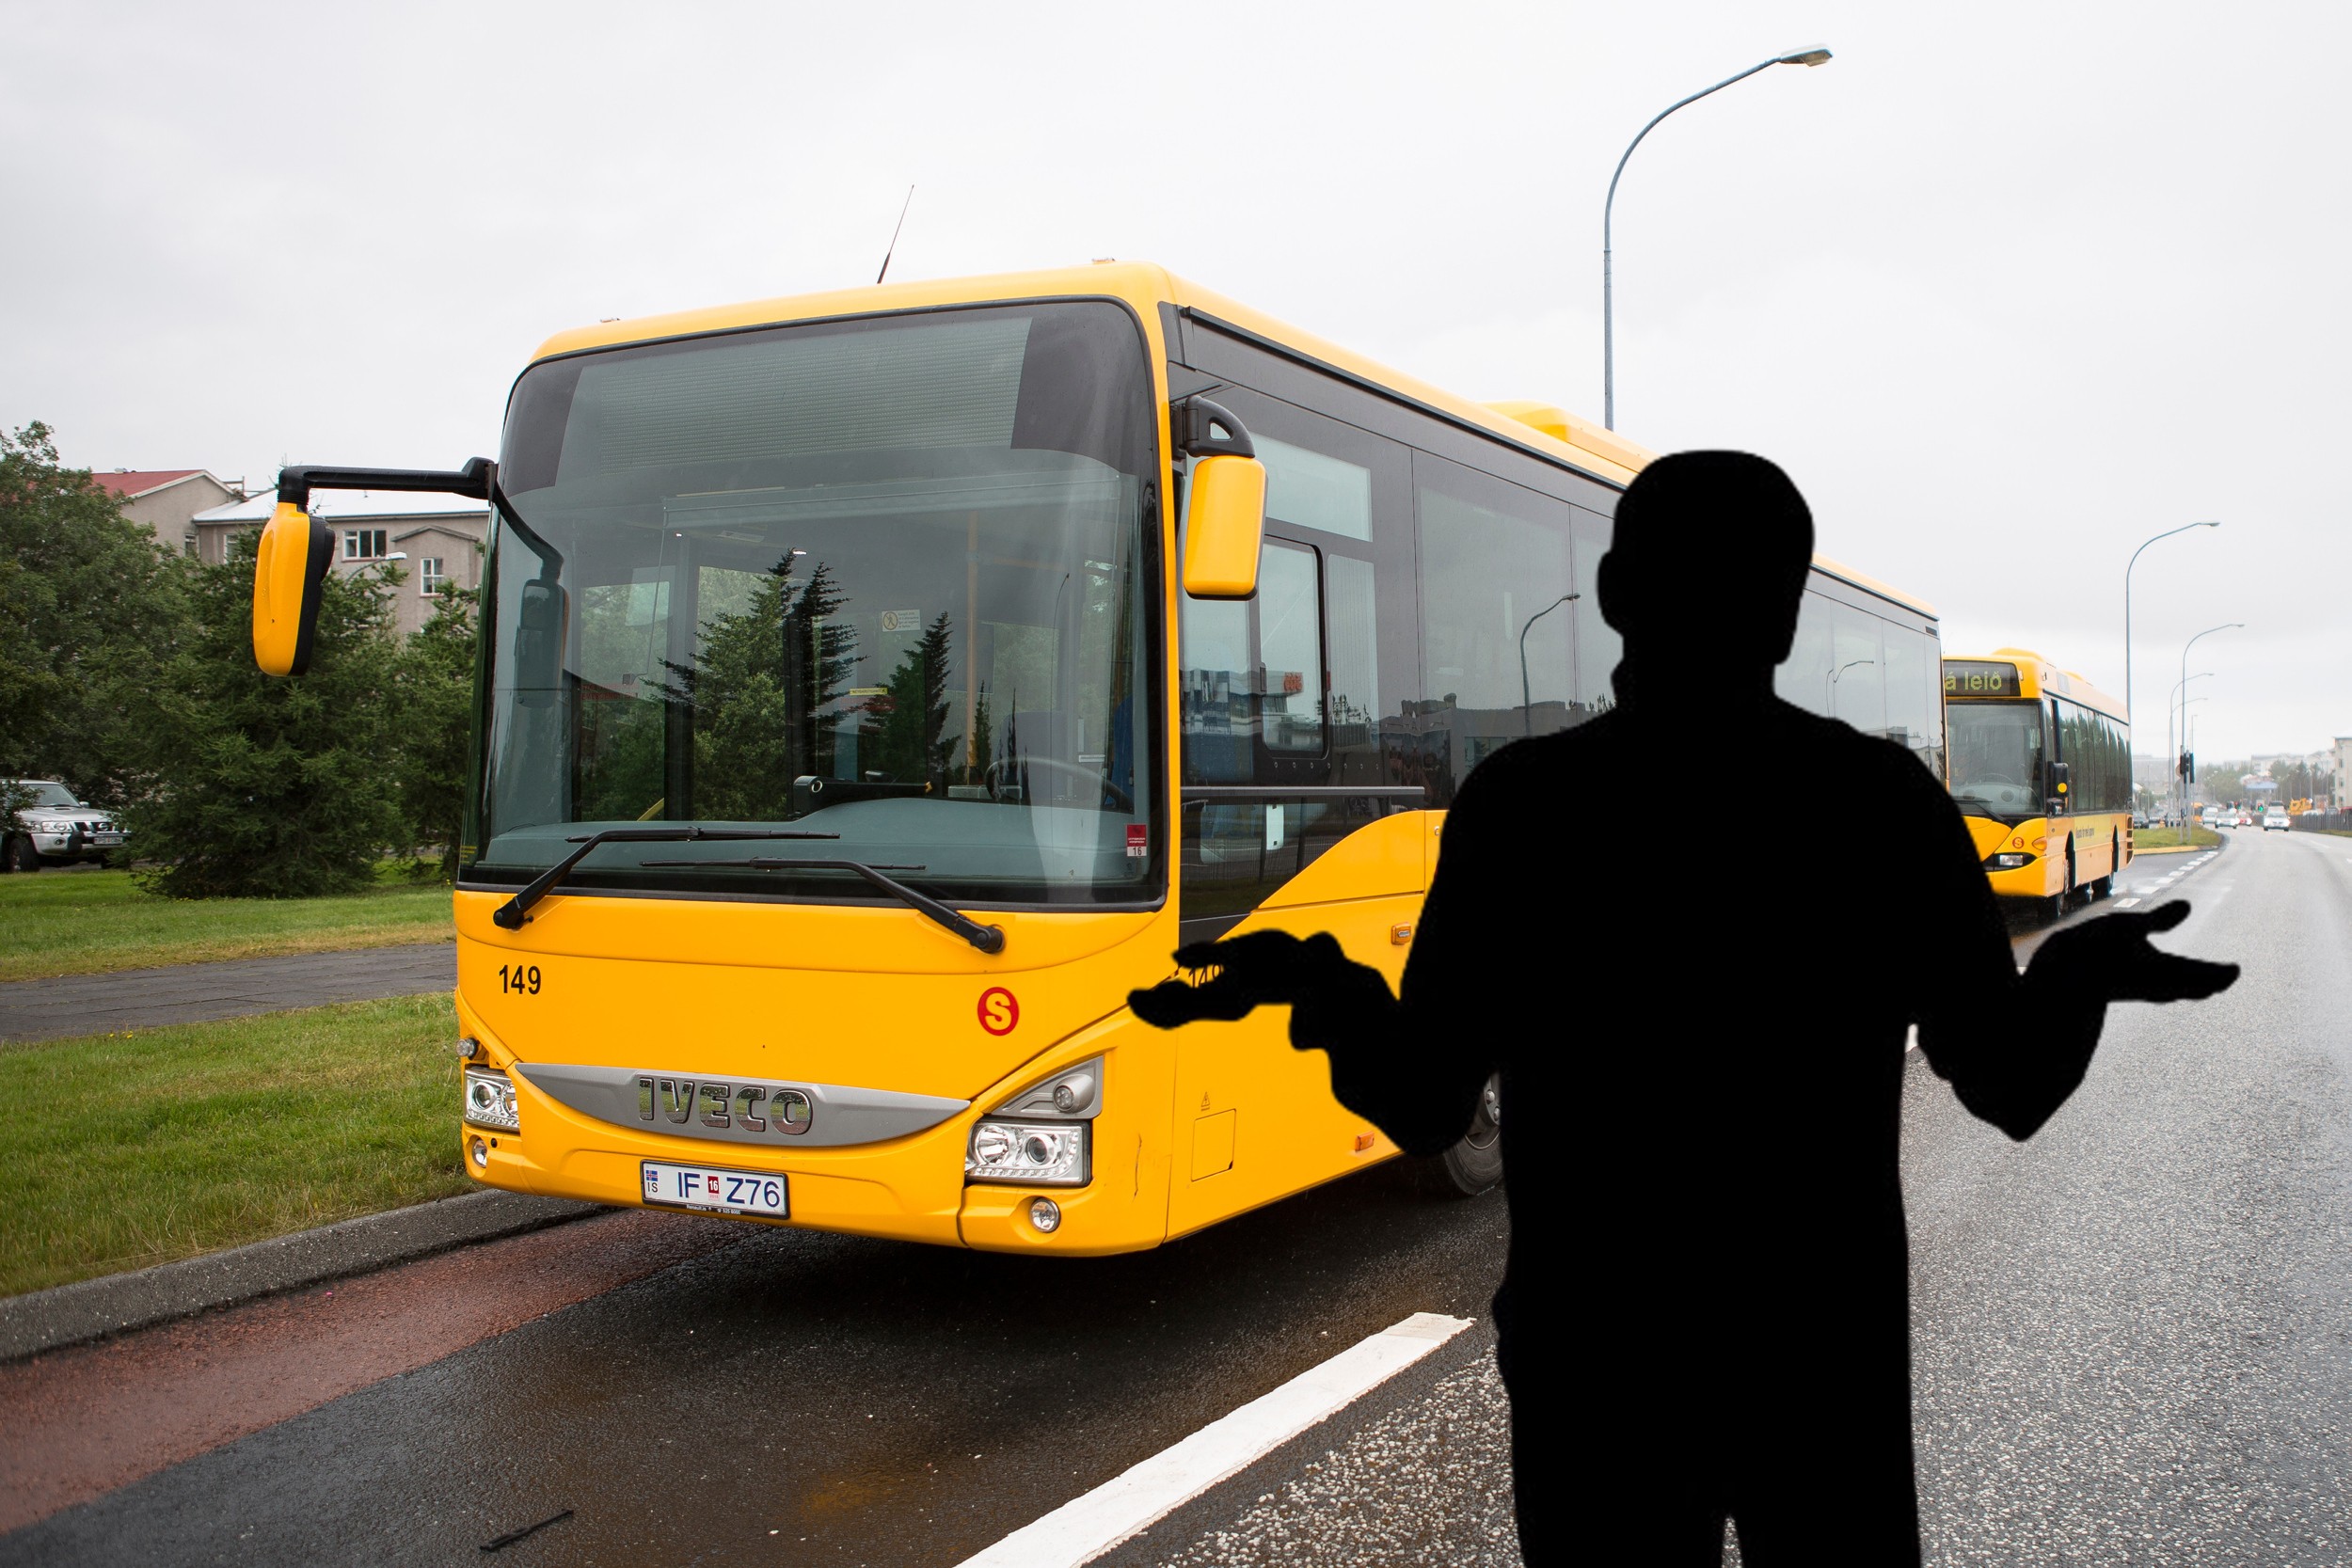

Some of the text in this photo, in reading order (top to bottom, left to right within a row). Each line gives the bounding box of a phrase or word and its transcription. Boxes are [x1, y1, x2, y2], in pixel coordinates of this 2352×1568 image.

[1945, 671, 1957, 690] á
[1132, 847, 1142, 856] 16
[499, 964, 542, 995] 149
[983, 990, 1014, 1032] S
[638, 1076, 815, 1136] IVECO
[646, 1181, 659, 1193] IS
[677, 1171, 781, 1208] IF Z76
[708, 1180, 719, 1192] 16
